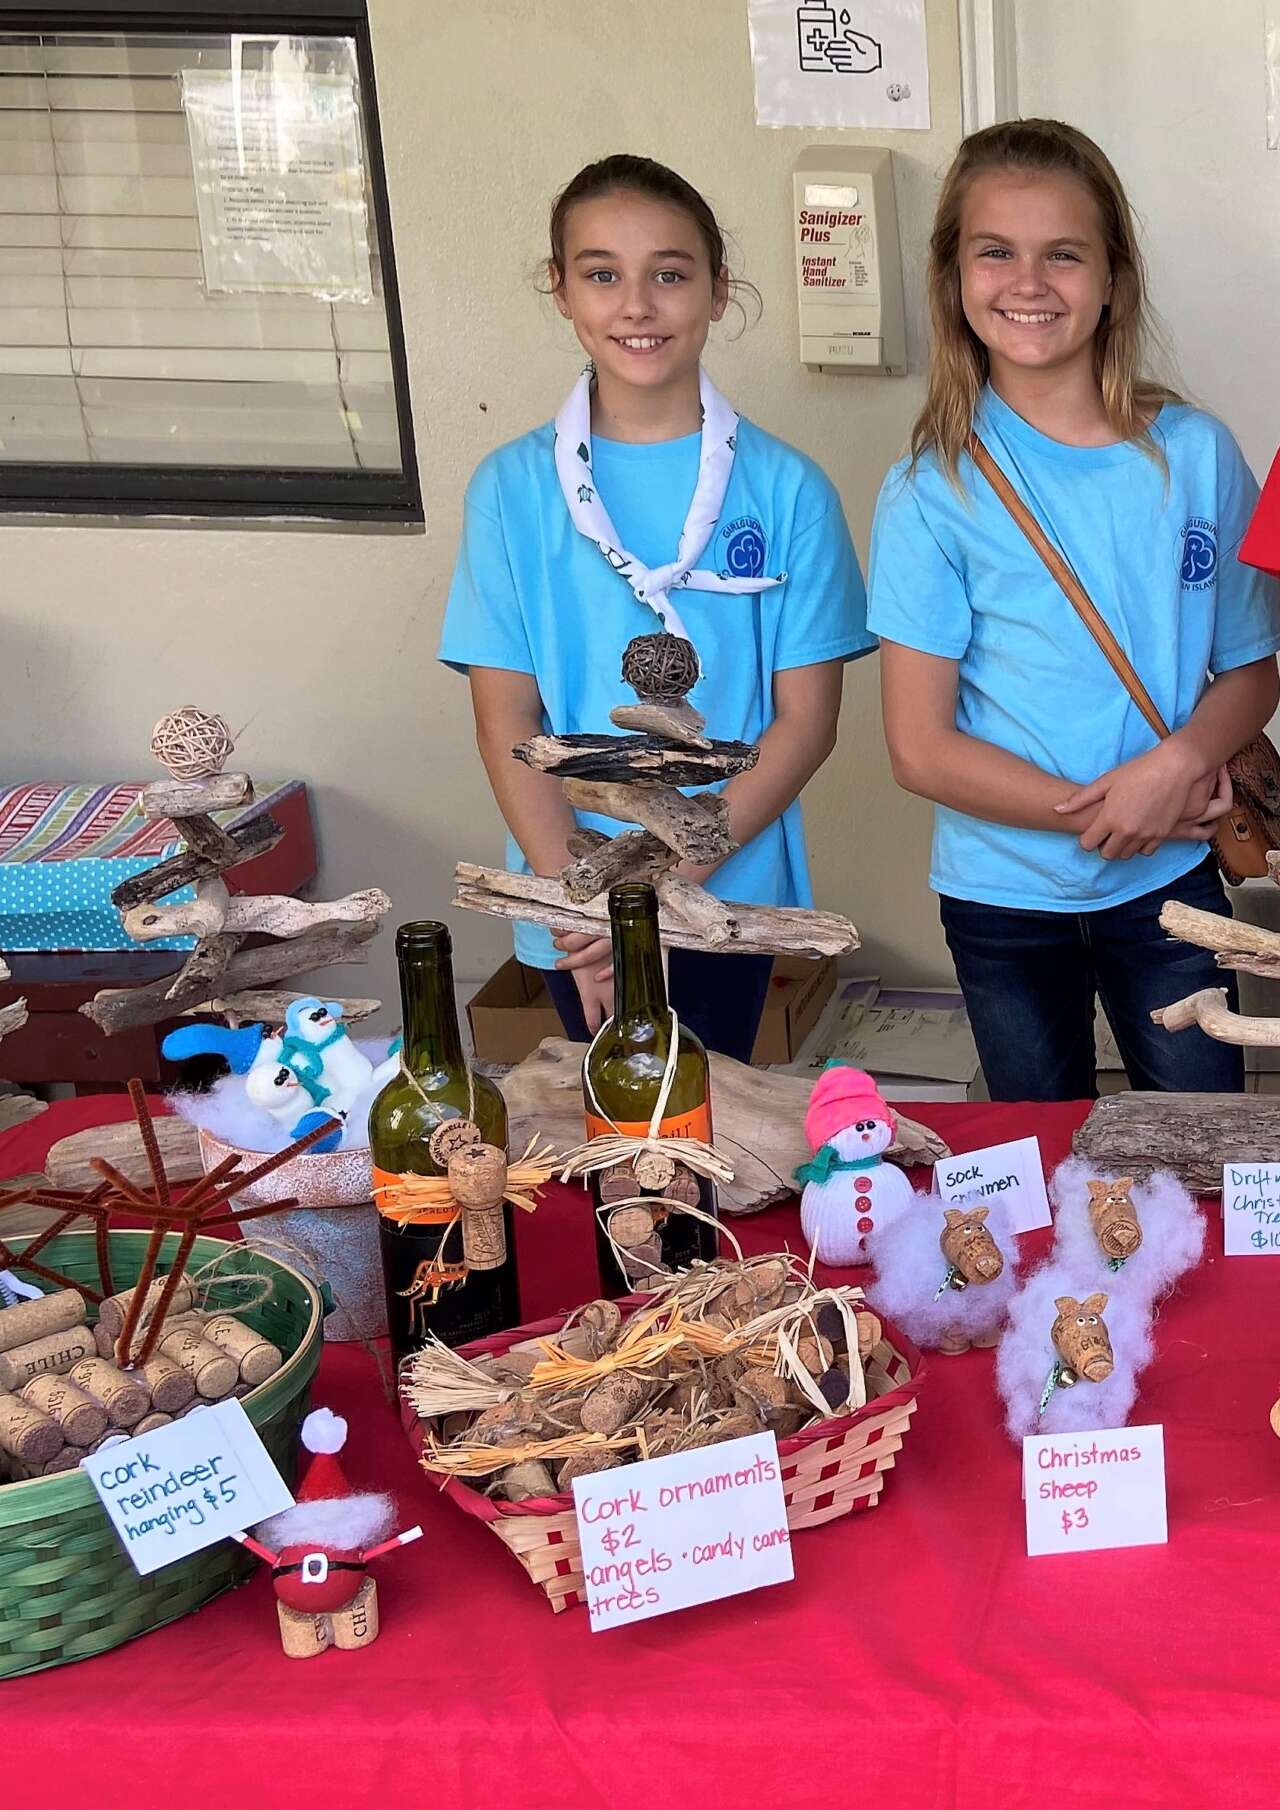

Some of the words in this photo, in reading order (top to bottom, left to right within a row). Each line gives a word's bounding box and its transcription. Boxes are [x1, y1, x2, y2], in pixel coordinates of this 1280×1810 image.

[799, 210, 862, 228] Sanigizer
[800, 228, 831, 242] Plus
[802, 256, 837, 266] Instant
[803, 266, 828, 276] Hand
[803, 276, 846, 287] Sanitizer
[25, 1345, 86, 1375] CHILE
[1038, 1442, 1142, 1469] Christmas
[117, 1456, 223, 1515] reindeer
[581, 1489, 648, 1524] Cork
[658, 1454, 777, 1507] ornaments
[124, 1498, 205, 1540] hanging
[203, 1475, 238, 1510] $5
[1061, 1507, 1089, 1535] $3
[601, 1523, 642, 1557] $2
